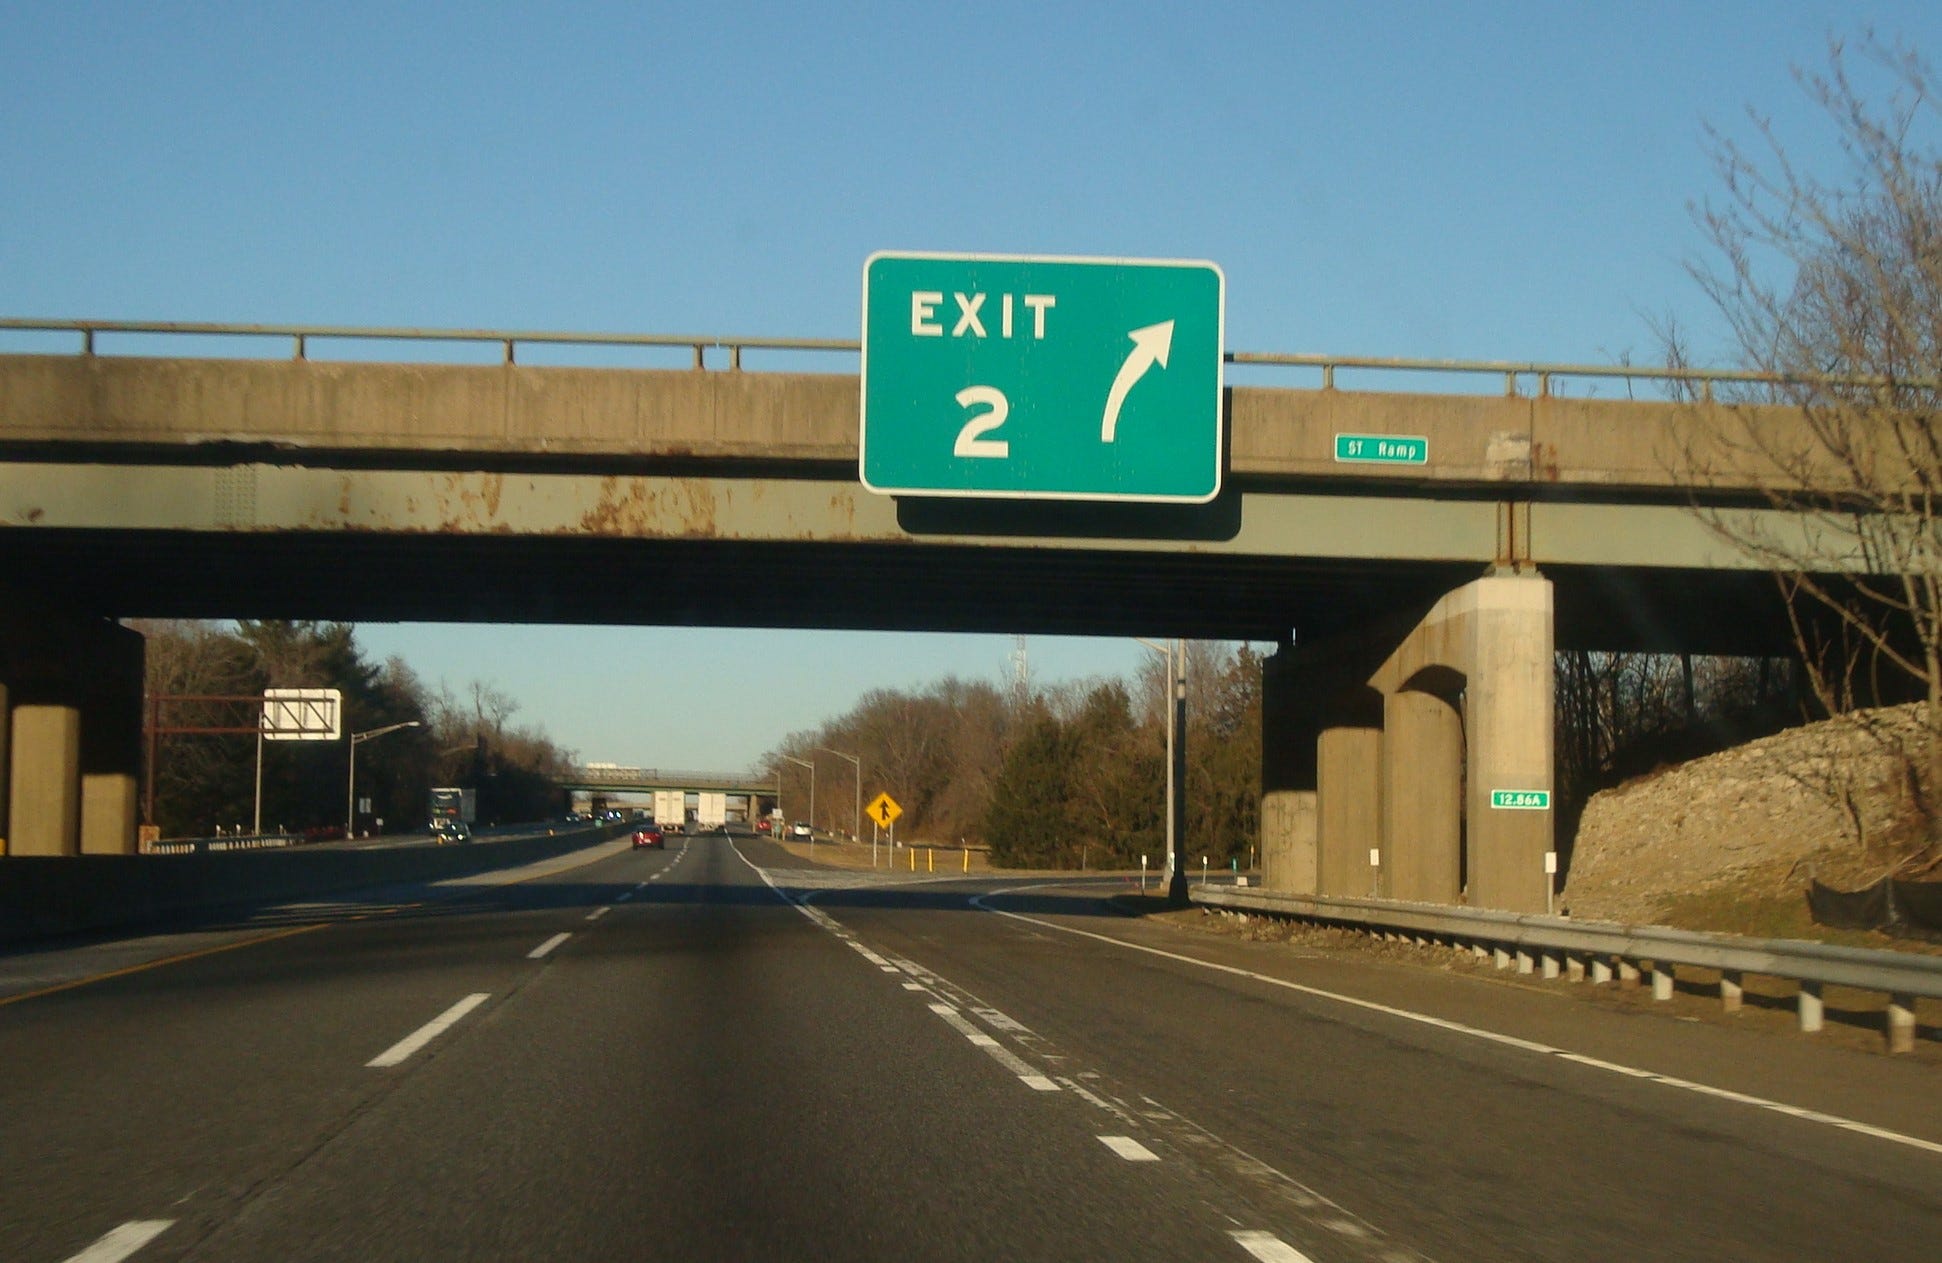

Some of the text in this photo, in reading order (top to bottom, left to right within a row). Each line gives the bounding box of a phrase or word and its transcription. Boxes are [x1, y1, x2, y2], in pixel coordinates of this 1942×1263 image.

[911, 291, 1056, 339] EXIT
[953, 385, 1009, 458] 2
[1379, 442, 1416, 460] Ramp
[1500, 793, 1541, 806] 12.86A
